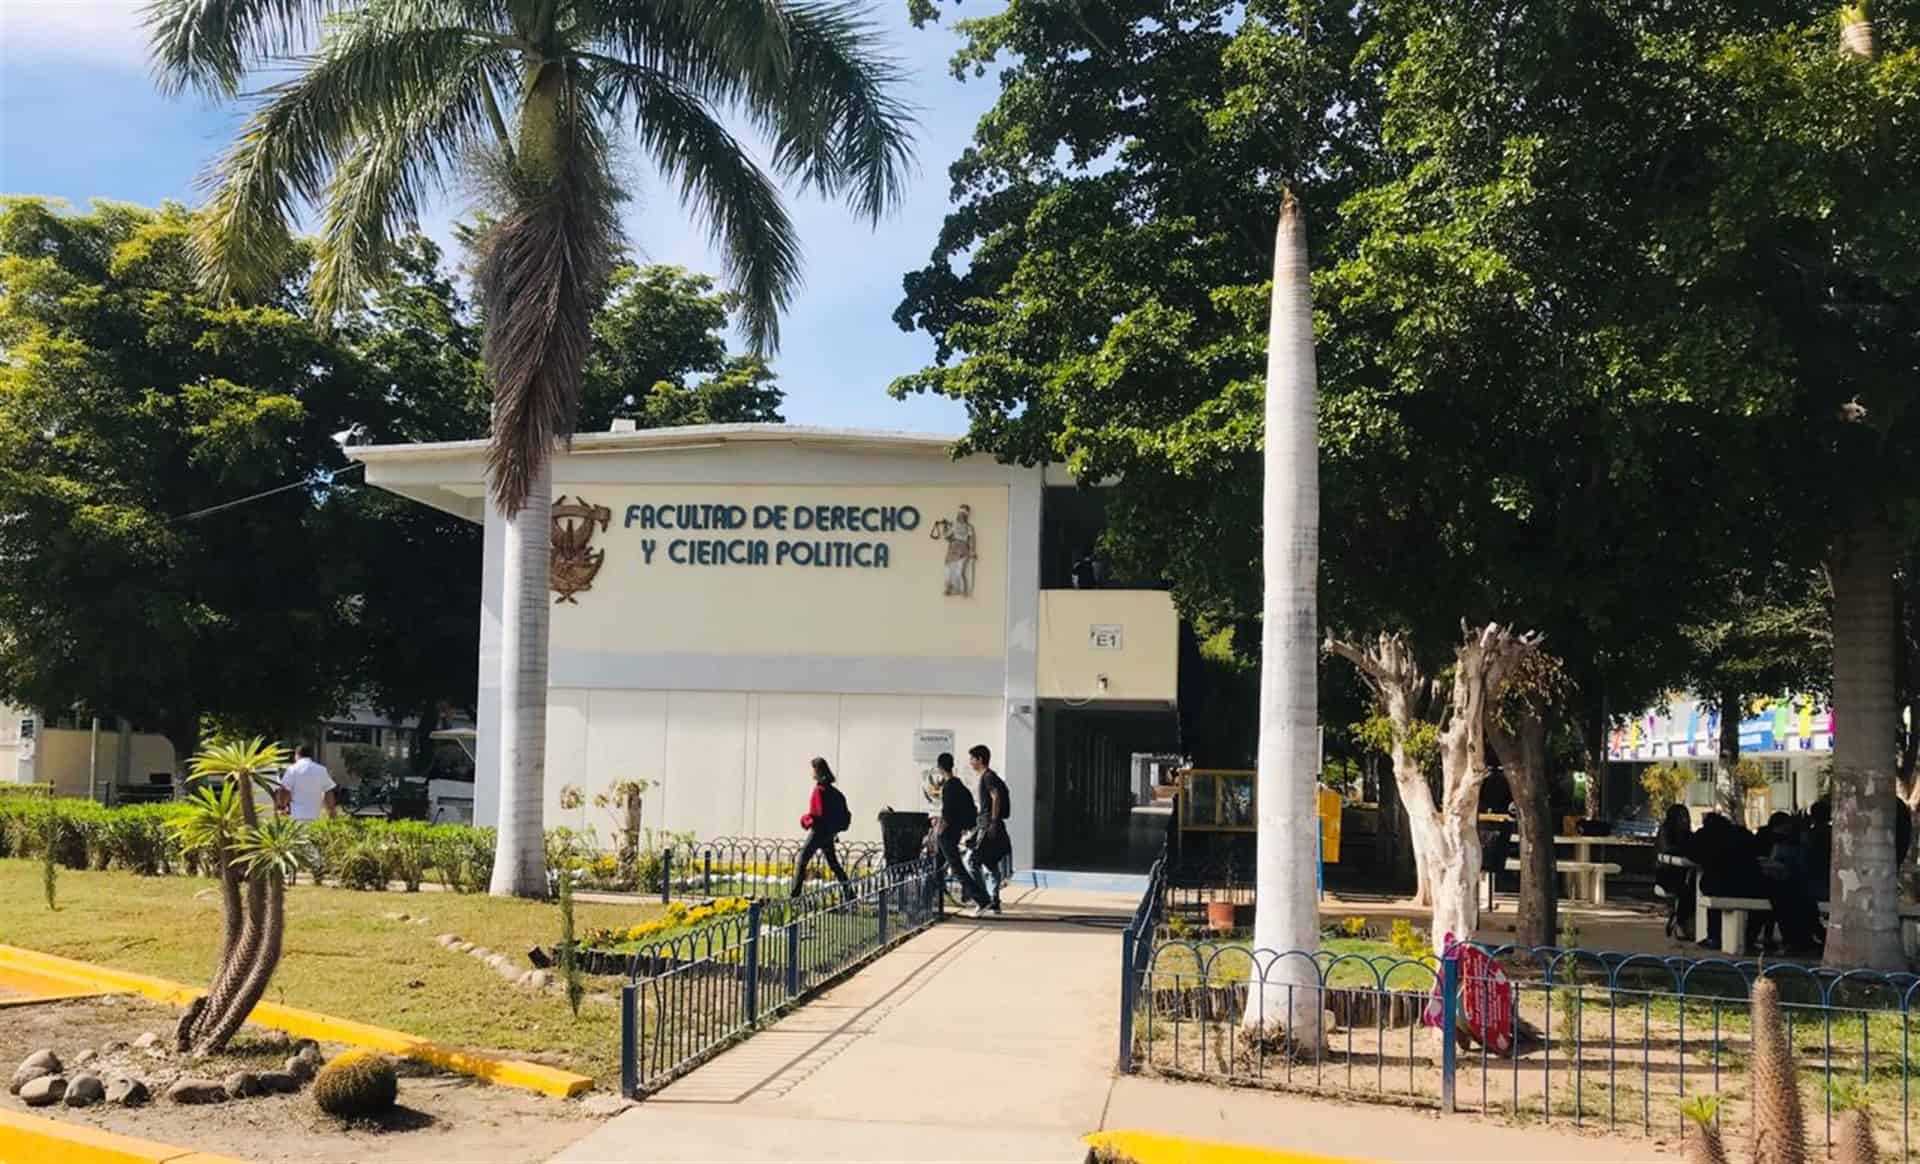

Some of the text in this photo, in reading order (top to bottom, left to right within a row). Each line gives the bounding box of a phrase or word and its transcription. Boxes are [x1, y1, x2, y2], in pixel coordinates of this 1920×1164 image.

[624, 504, 921, 532] FACULTAD DE DERECHO
[641, 539, 889, 568] Y CIENCIA POLITICA
